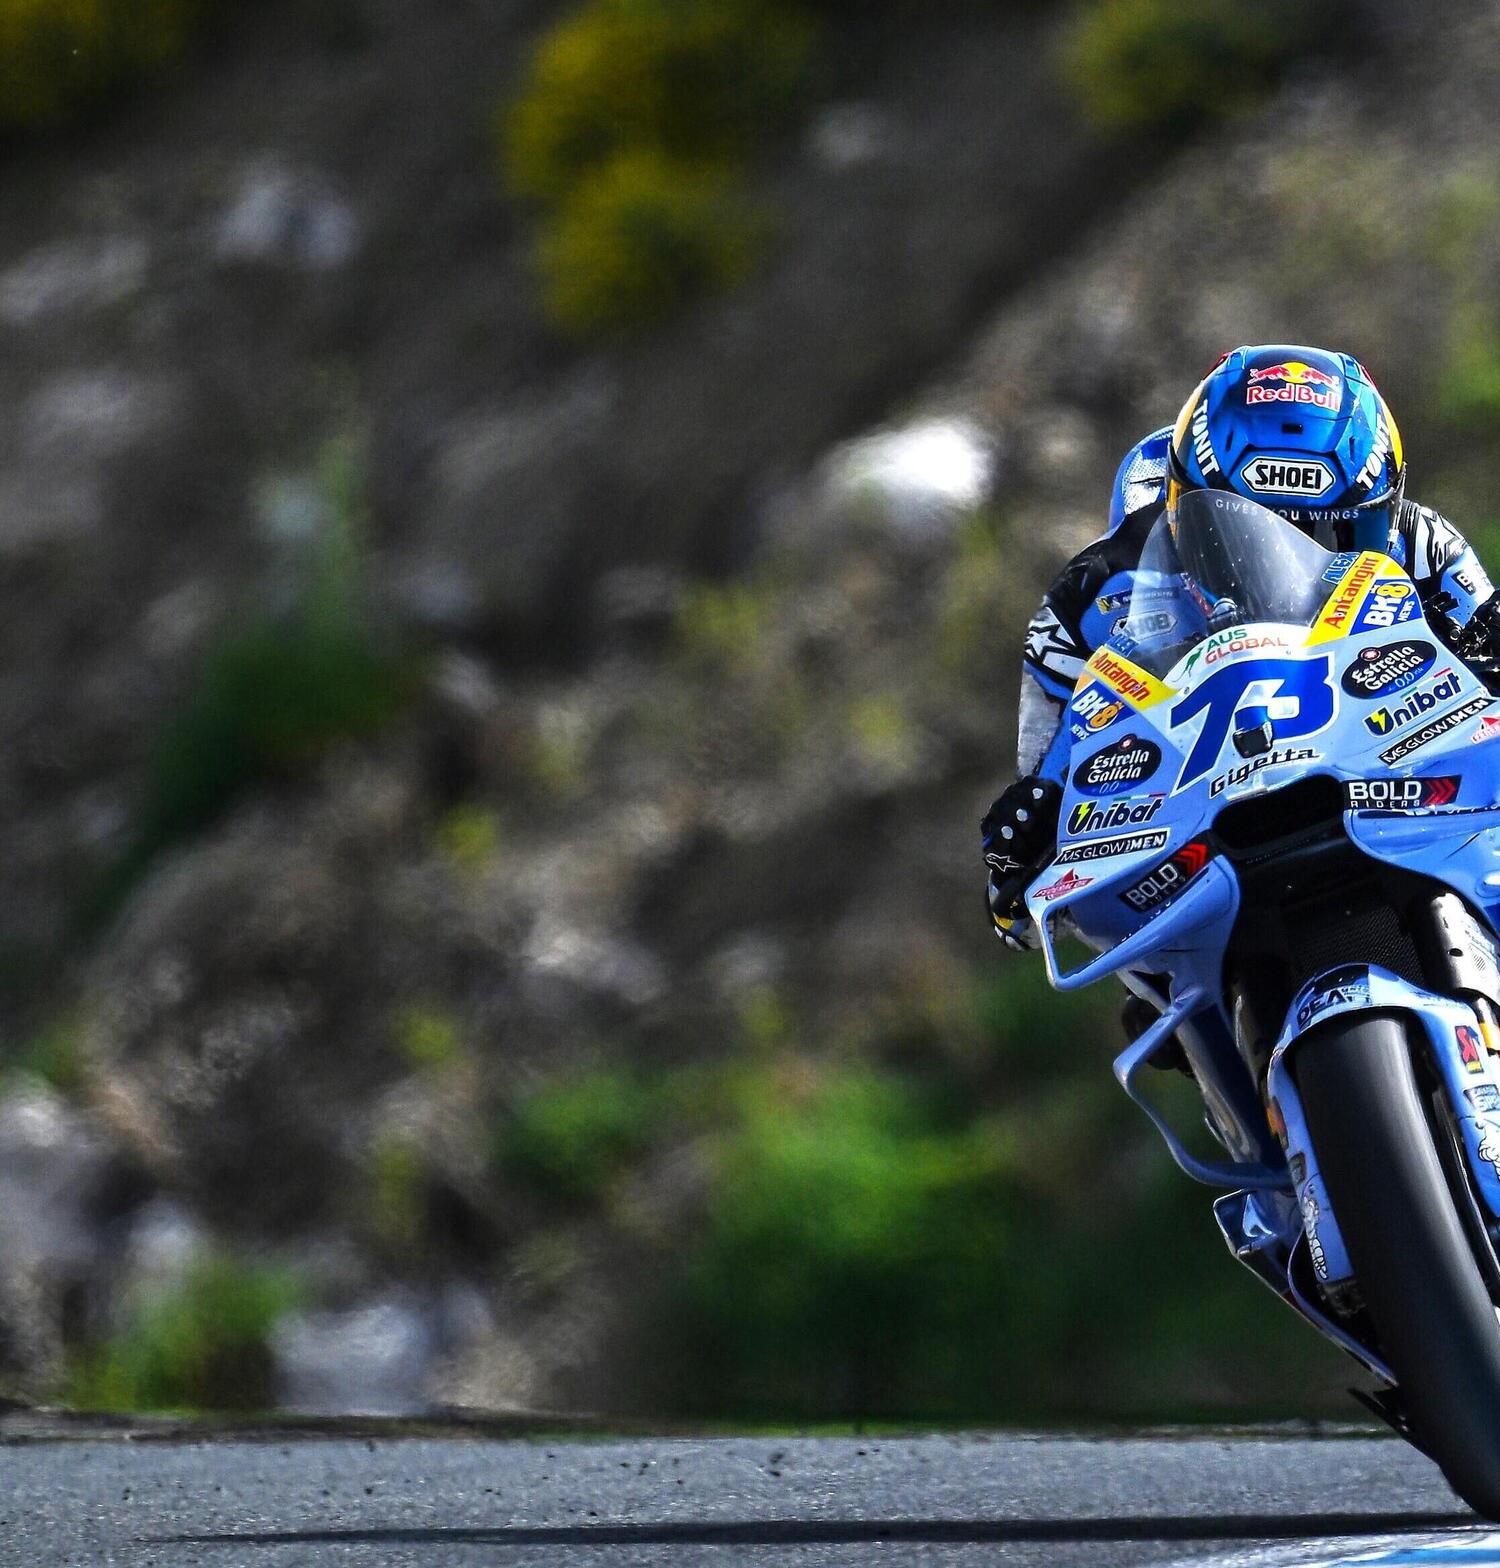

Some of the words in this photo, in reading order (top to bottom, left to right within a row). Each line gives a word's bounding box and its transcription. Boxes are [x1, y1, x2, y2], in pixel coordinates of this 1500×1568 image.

[1247, 384, 1293, 404] Red
[1299, 384, 1341, 412] Bull
[1254, 463, 1321, 490] SHOEI
[1215, 499, 1258, 516] GIVES
[1309, 509, 1360, 521] WINGS
[1323, 557, 1380, 629] Antangin
[1362, 582, 1413, 627] BK8
[1205, 636, 1289, 665] GLOBAL
[1207, 628, 1248, 652] AUS
[1093, 653, 1151, 702] Antangin
[1351, 645, 1415, 684] Estrella
[1365, 655, 1424, 690] Galicia
[1072, 690, 1118, 732] BK8
[1364, 672, 1461, 736] Unibat
[1170, 655, 1334, 790] 73
[1090, 750, 1149, 769] Estrella
[1382, 745, 1407, 762] MS
[1405, 721, 1448, 750] GLOW
[1087, 765, 1141, 783] Galicia
[1211, 748, 1320, 797] Gigetta
[1349, 781, 1422, 800] BOLD
[1067, 797, 1163, 835] Unibat
[1351, 801, 1419, 809] RIDERS
[1061, 850, 1081, 862] MS
[1083, 842, 1124, 858] GLOW
[1126, 863, 1178, 905] BOLD
